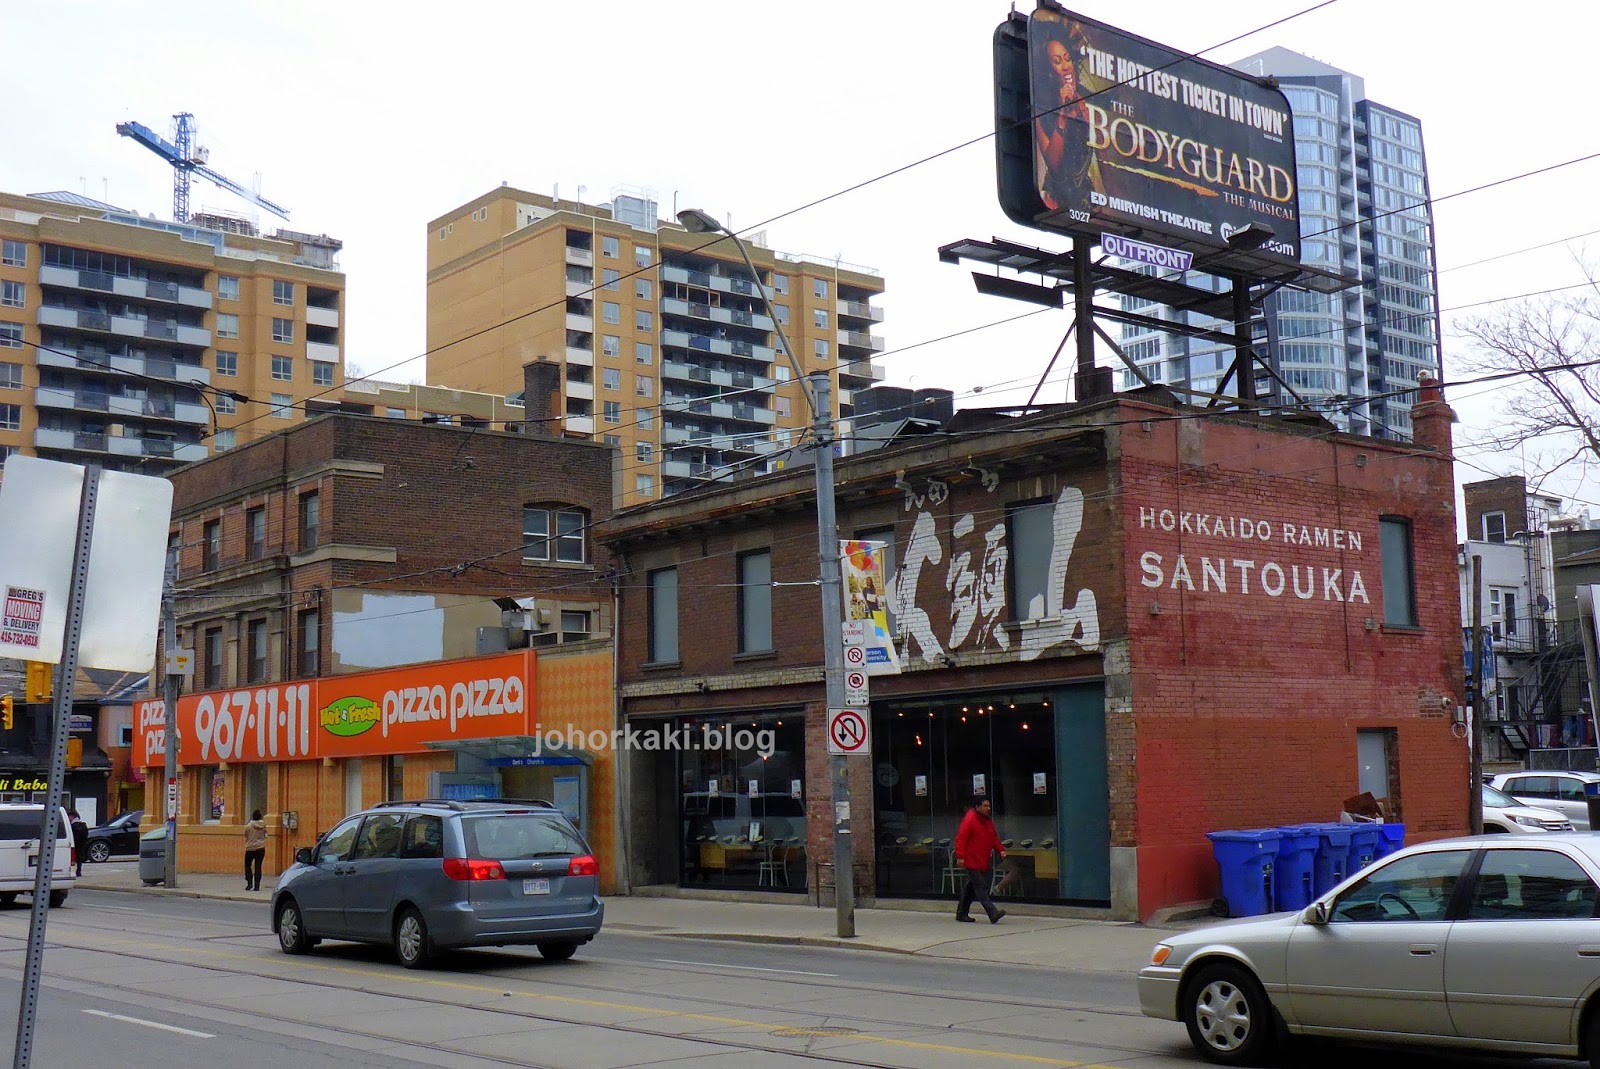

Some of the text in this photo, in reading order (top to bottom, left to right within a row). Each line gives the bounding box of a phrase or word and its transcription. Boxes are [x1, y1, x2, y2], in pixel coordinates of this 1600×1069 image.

[1117, 57, 1179, 102] HOTTEST
[1180, 79, 1226, 117] TICKET
[1229, 95, 1245, 124] IN
[1110, 100, 1135, 117] THE
[1085, 102, 1295, 203] BODYGUARD
[1069, 208, 1091, 224] 3027
[1090, 191, 1213, 235] ED MIRVISH THEATRE
[1222, 191, 1296, 221] THE MUSICAL
[1104, 235, 1188, 270] OUTFRONT
[1139, 506, 1363, 551] HOKKAIDO RAMEN
[1139, 551, 1371, 604] SANTOUKA
[16, 589, 44, 601] GREG'S
[3, 617, 8, 627] &
[10, 618, 40, 631] DELIVERY
[6, 600, 41, 620] MOVING
[320, 701, 381, 727] Hot & Fresh
[13, 779, 48, 790] Baba
